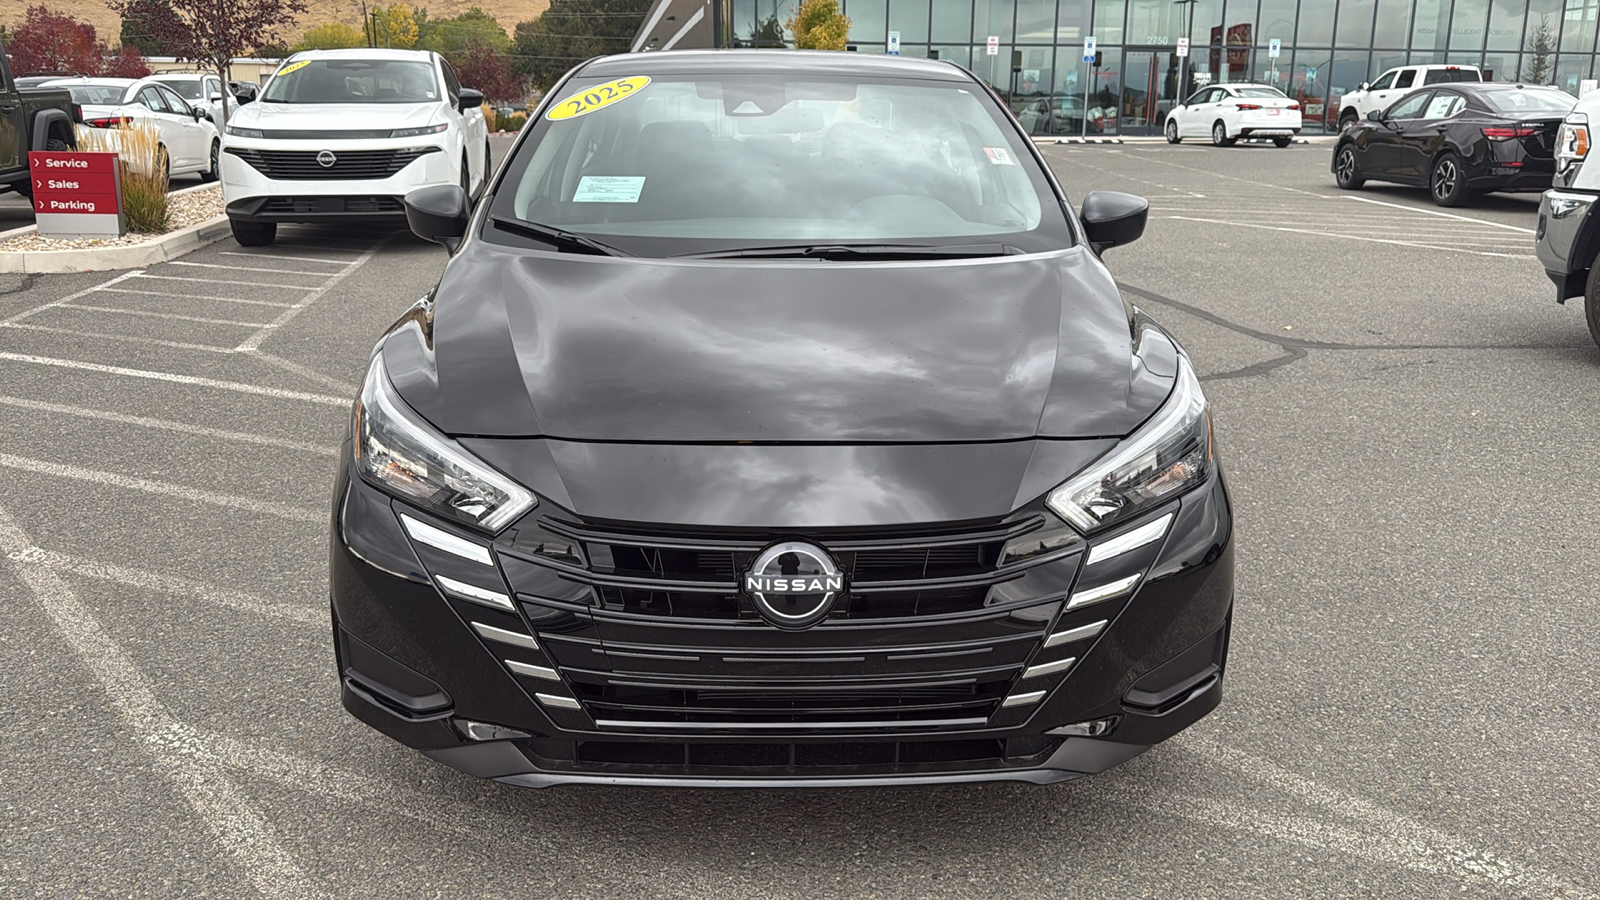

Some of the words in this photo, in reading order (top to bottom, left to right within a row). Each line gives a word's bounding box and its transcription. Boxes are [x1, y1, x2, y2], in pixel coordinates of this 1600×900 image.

[1147, 36, 1168, 45] 2750
[567, 80, 633, 114] 2025
[45, 158, 88, 168] Service
[48, 180, 79, 189] Sales
[50, 200, 95, 212] Parking
[747, 577, 841, 592] NISSAN
